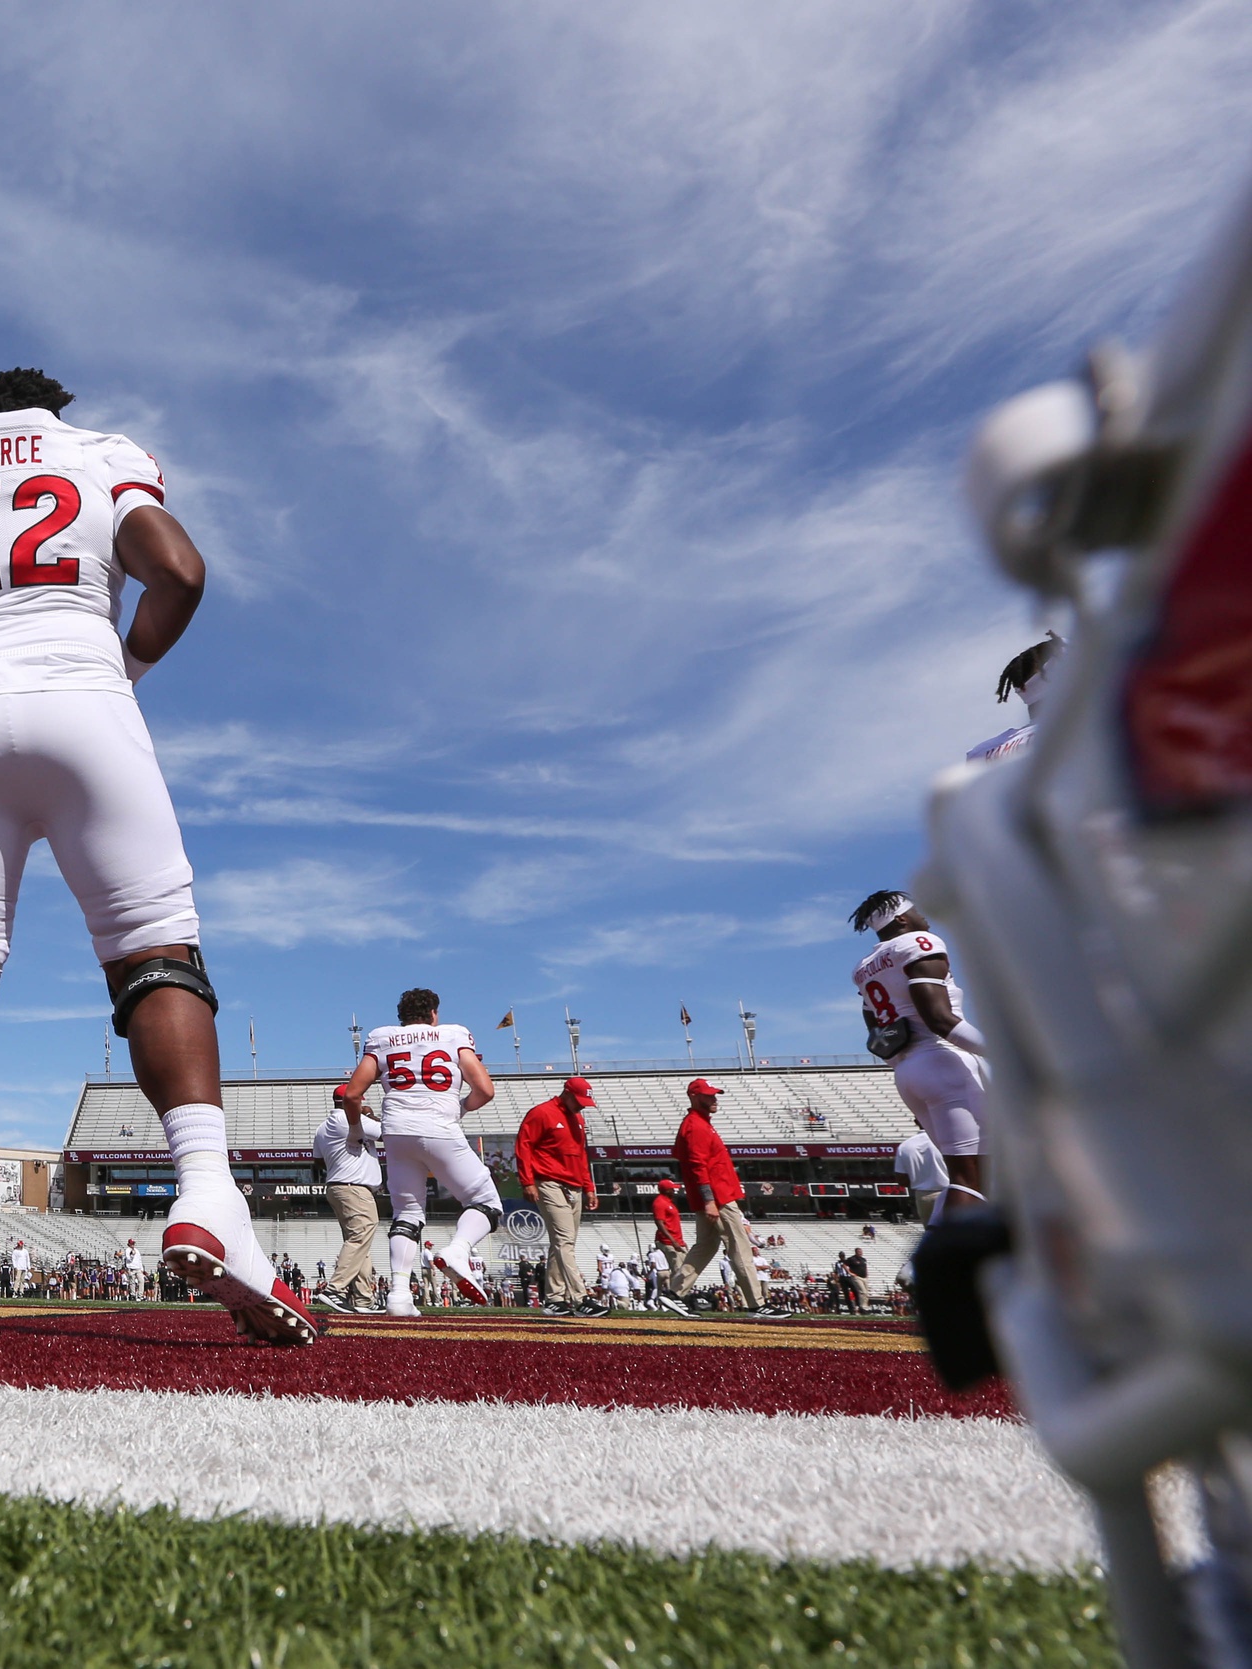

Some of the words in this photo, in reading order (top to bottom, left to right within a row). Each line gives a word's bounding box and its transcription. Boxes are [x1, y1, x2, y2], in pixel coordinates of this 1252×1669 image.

[915, 936, 933, 951] 8
[865, 980, 899, 1028] 8
[386, 1050, 453, 1092] 56
[275, 1185, 311, 1195] ALUMNI
